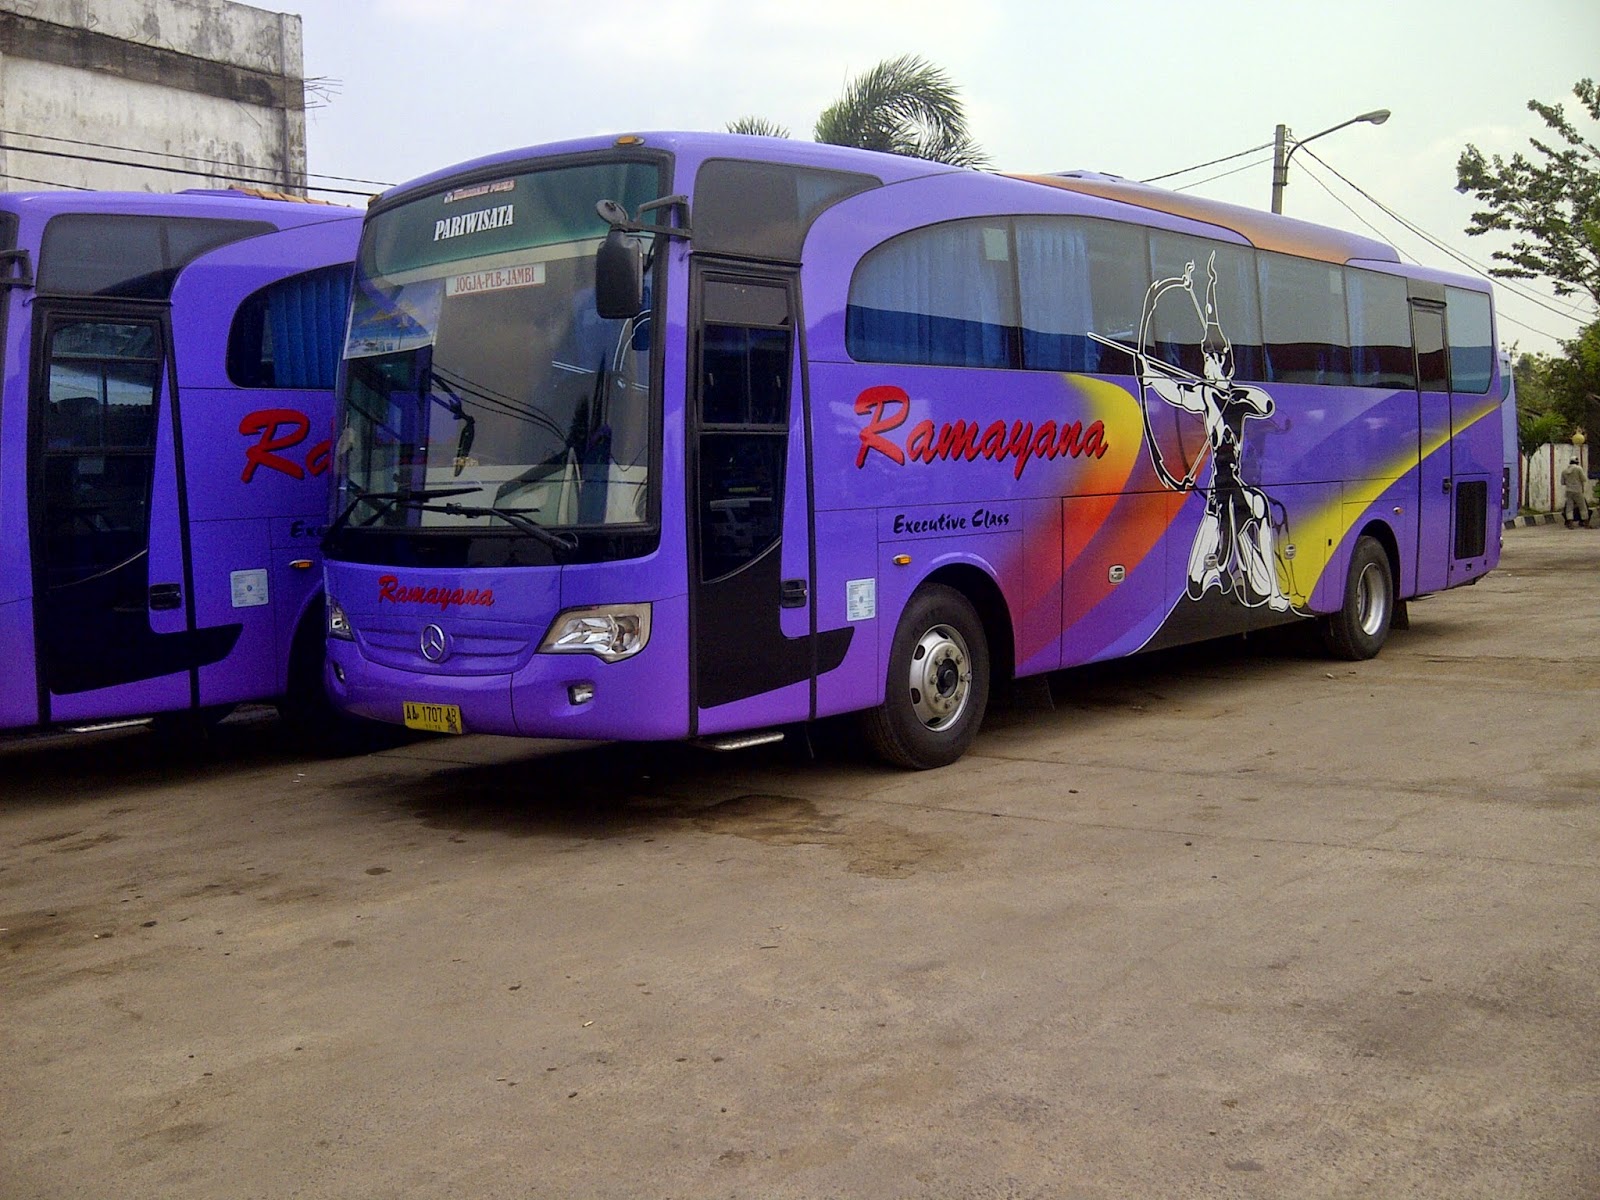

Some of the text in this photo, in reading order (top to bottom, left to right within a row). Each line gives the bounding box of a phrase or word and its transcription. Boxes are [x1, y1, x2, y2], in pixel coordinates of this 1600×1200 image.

[433, 204, 514, 242] PARIWISATA
[854, 385, 1109, 481] Ramayana
[893, 508, 1010, 535] Executive Class
[377, 574, 496, 611] Ramayana
[422, 706, 443, 723] 1707
